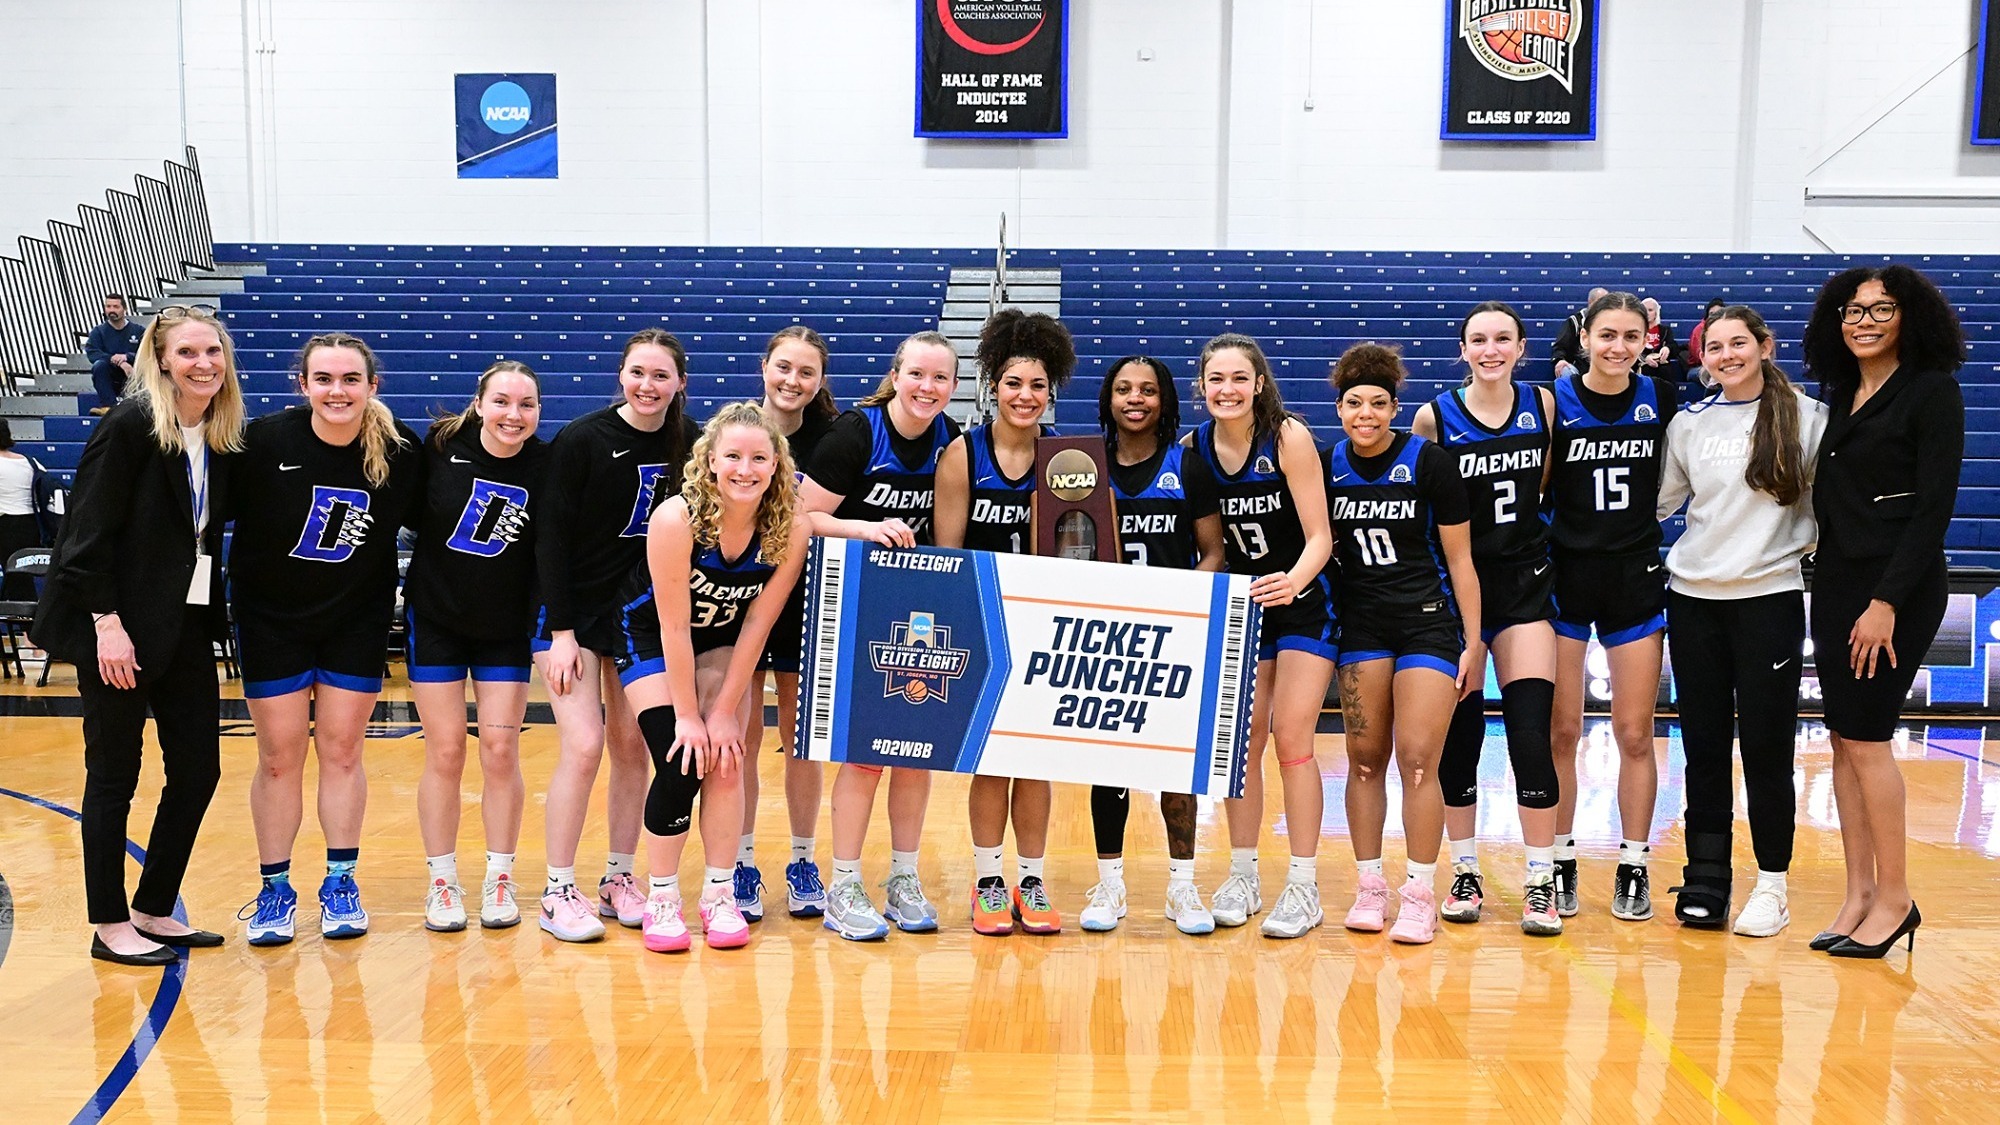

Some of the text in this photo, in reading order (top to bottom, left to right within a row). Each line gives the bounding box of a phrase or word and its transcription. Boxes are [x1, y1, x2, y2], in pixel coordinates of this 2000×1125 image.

[1509, 11, 1567, 37] HALL OF
[1472, 33, 1512, 72] SPRINGFIELD
[1524, 33, 1566, 75] FAME
[941, 74, 1043, 87] HALL OF FAME
[956, 92, 1027, 105] INDUCTEE
[485, 106, 530, 121] NCAA
[975, 110, 1008, 123] 2014
[1467, 111, 1571, 124] CLASS OF 2020
[1565, 437, 1654, 463] DAEMEN
[1700, 435, 1750, 460] DAE
[1458, 448, 1542, 479] DAEMEN
[1051, 472, 1097, 489] NCAA
[1592, 467, 1630, 511] 15
[863, 482, 934, 509] DAEME
[1219, 491, 1282, 515] EMEN
[1332, 496, 1417, 520] DAEMEN
[1493, 480, 1517, 524] 2
[971, 498, 1031, 524] DAEM
[1120, 514, 1177, 534] EMEN
[1228, 522, 1269, 560] 13
[1353, 528, 1399, 566] 10
[15, 554, 51, 569] BENT
[869, 549, 964, 574] #ELITEEIGHT
[690, 600, 739, 628] 33
[912, 624, 931, 632] NCAA
[1051, 615, 1173, 660] TICKET
[880, 650, 960, 671] ELITE EIGHT
[897, 646, 924, 654] DIVISION
[1024, 651, 1193, 699] PUNCHED
[1052, 694, 1149, 733] 2024
[871, 738, 934, 759] #D2WBB
